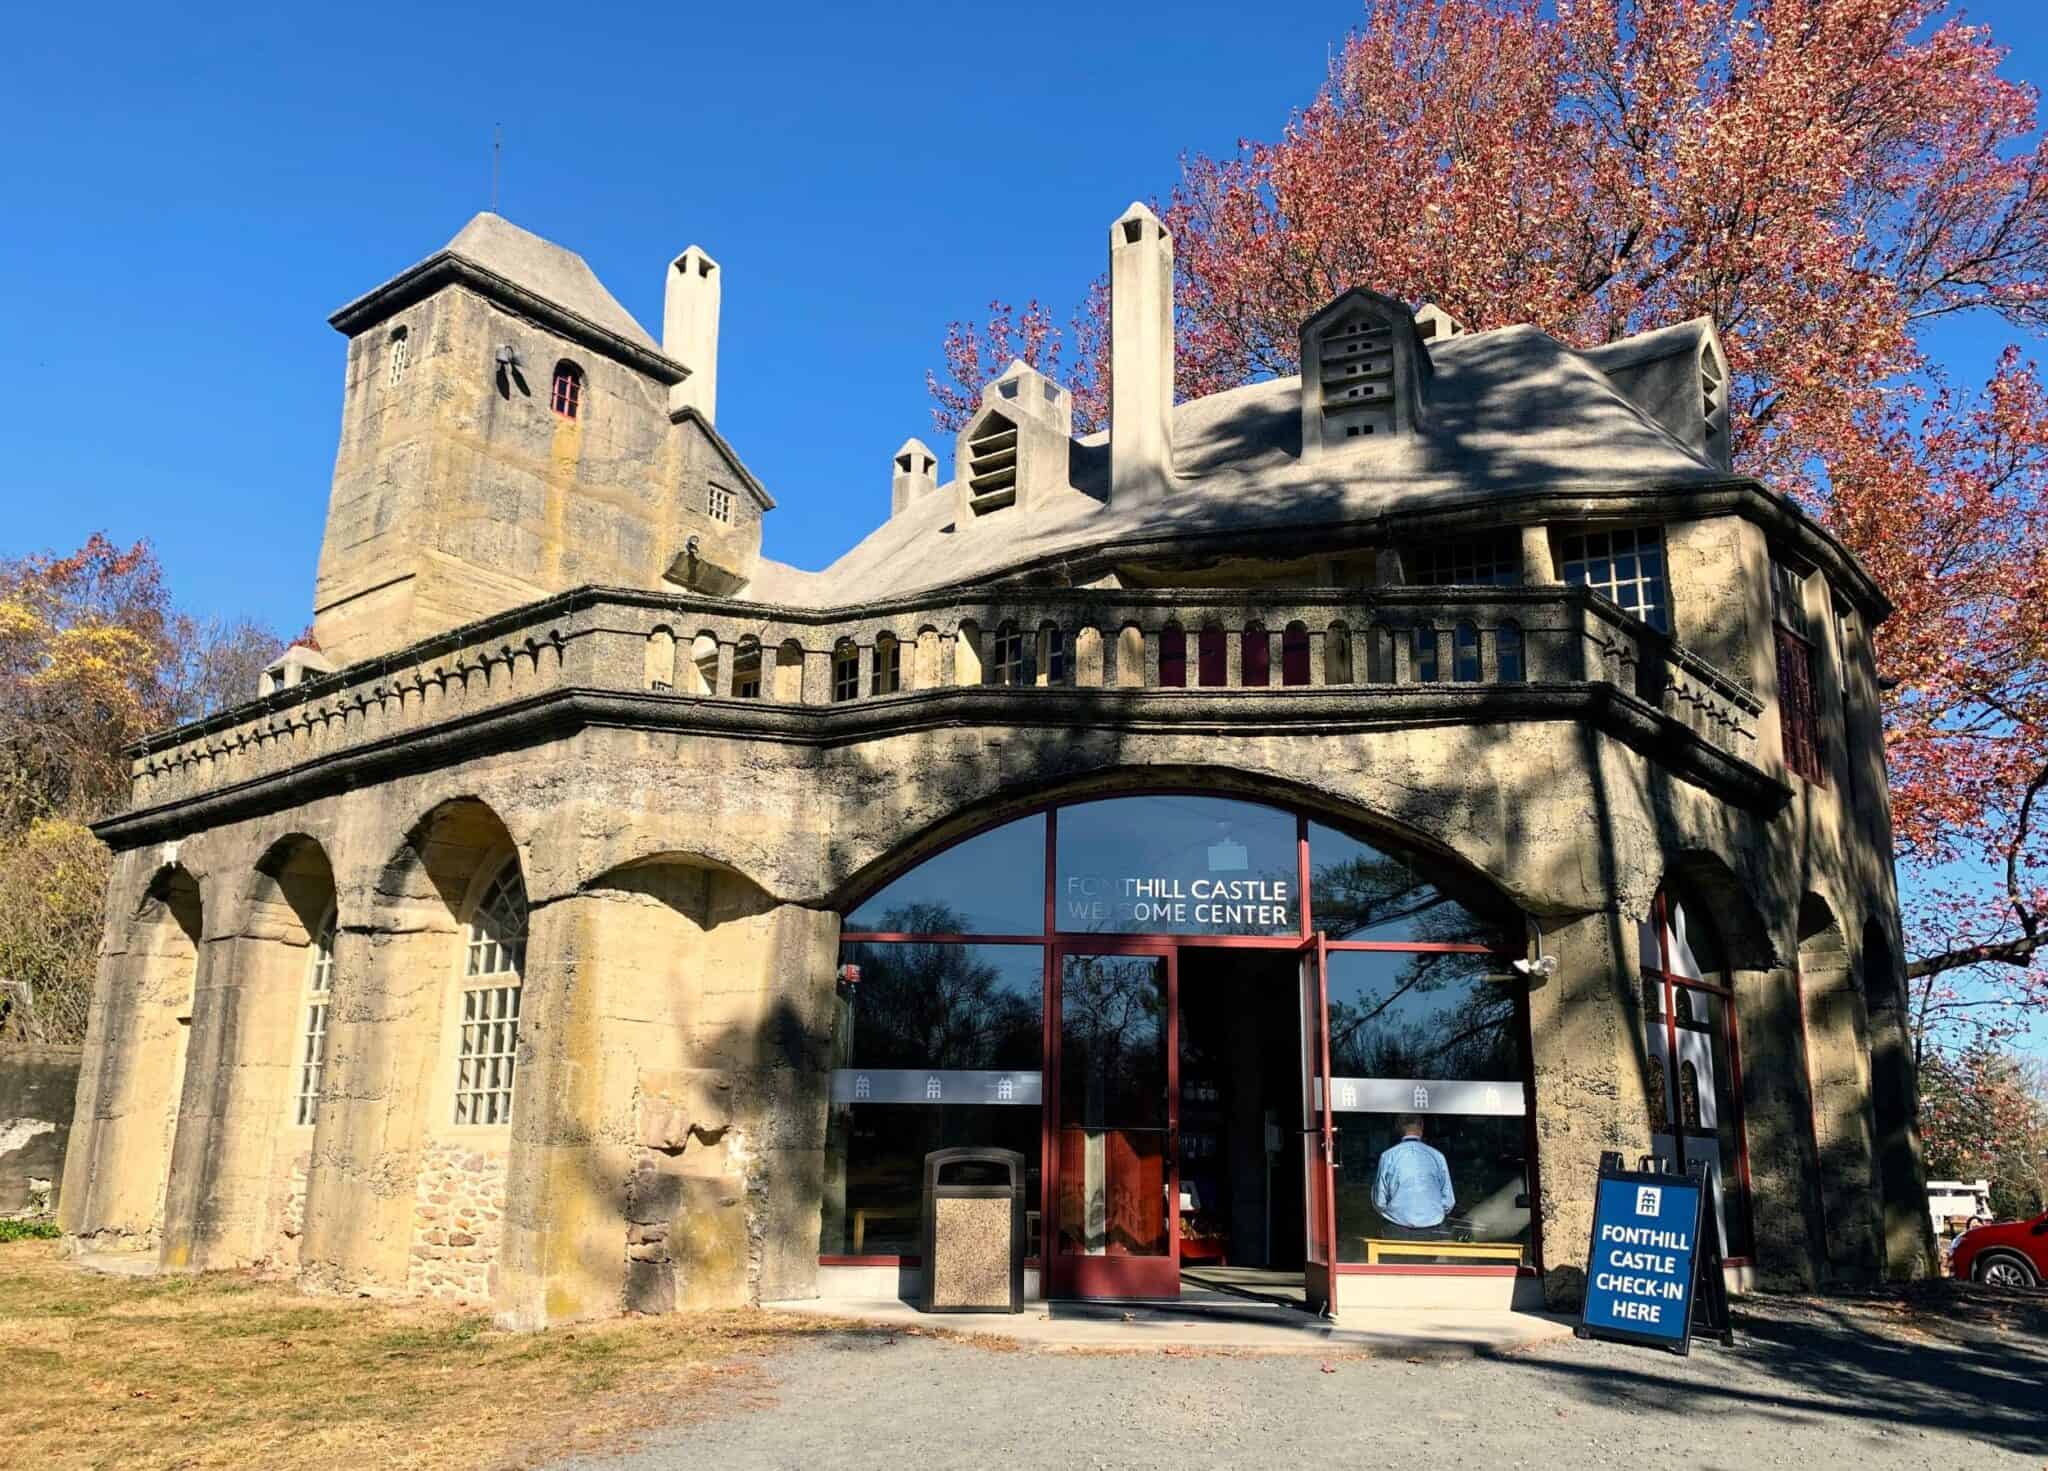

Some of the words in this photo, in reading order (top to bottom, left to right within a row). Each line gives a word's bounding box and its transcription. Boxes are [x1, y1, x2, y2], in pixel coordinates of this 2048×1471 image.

[1191, 879, 1287, 901] CASTLE
[1067, 901, 1187, 922] WEOME
[1194, 903, 1287, 925] CENTER
[1601, 1224, 1689, 1250] FONTHILL
[1610, 1250, 1676, 1274] CASTLE
[1596, 1273, 1683, 1300] CHECK-IN
[1612, 1300, 1662, 1323] HERE
